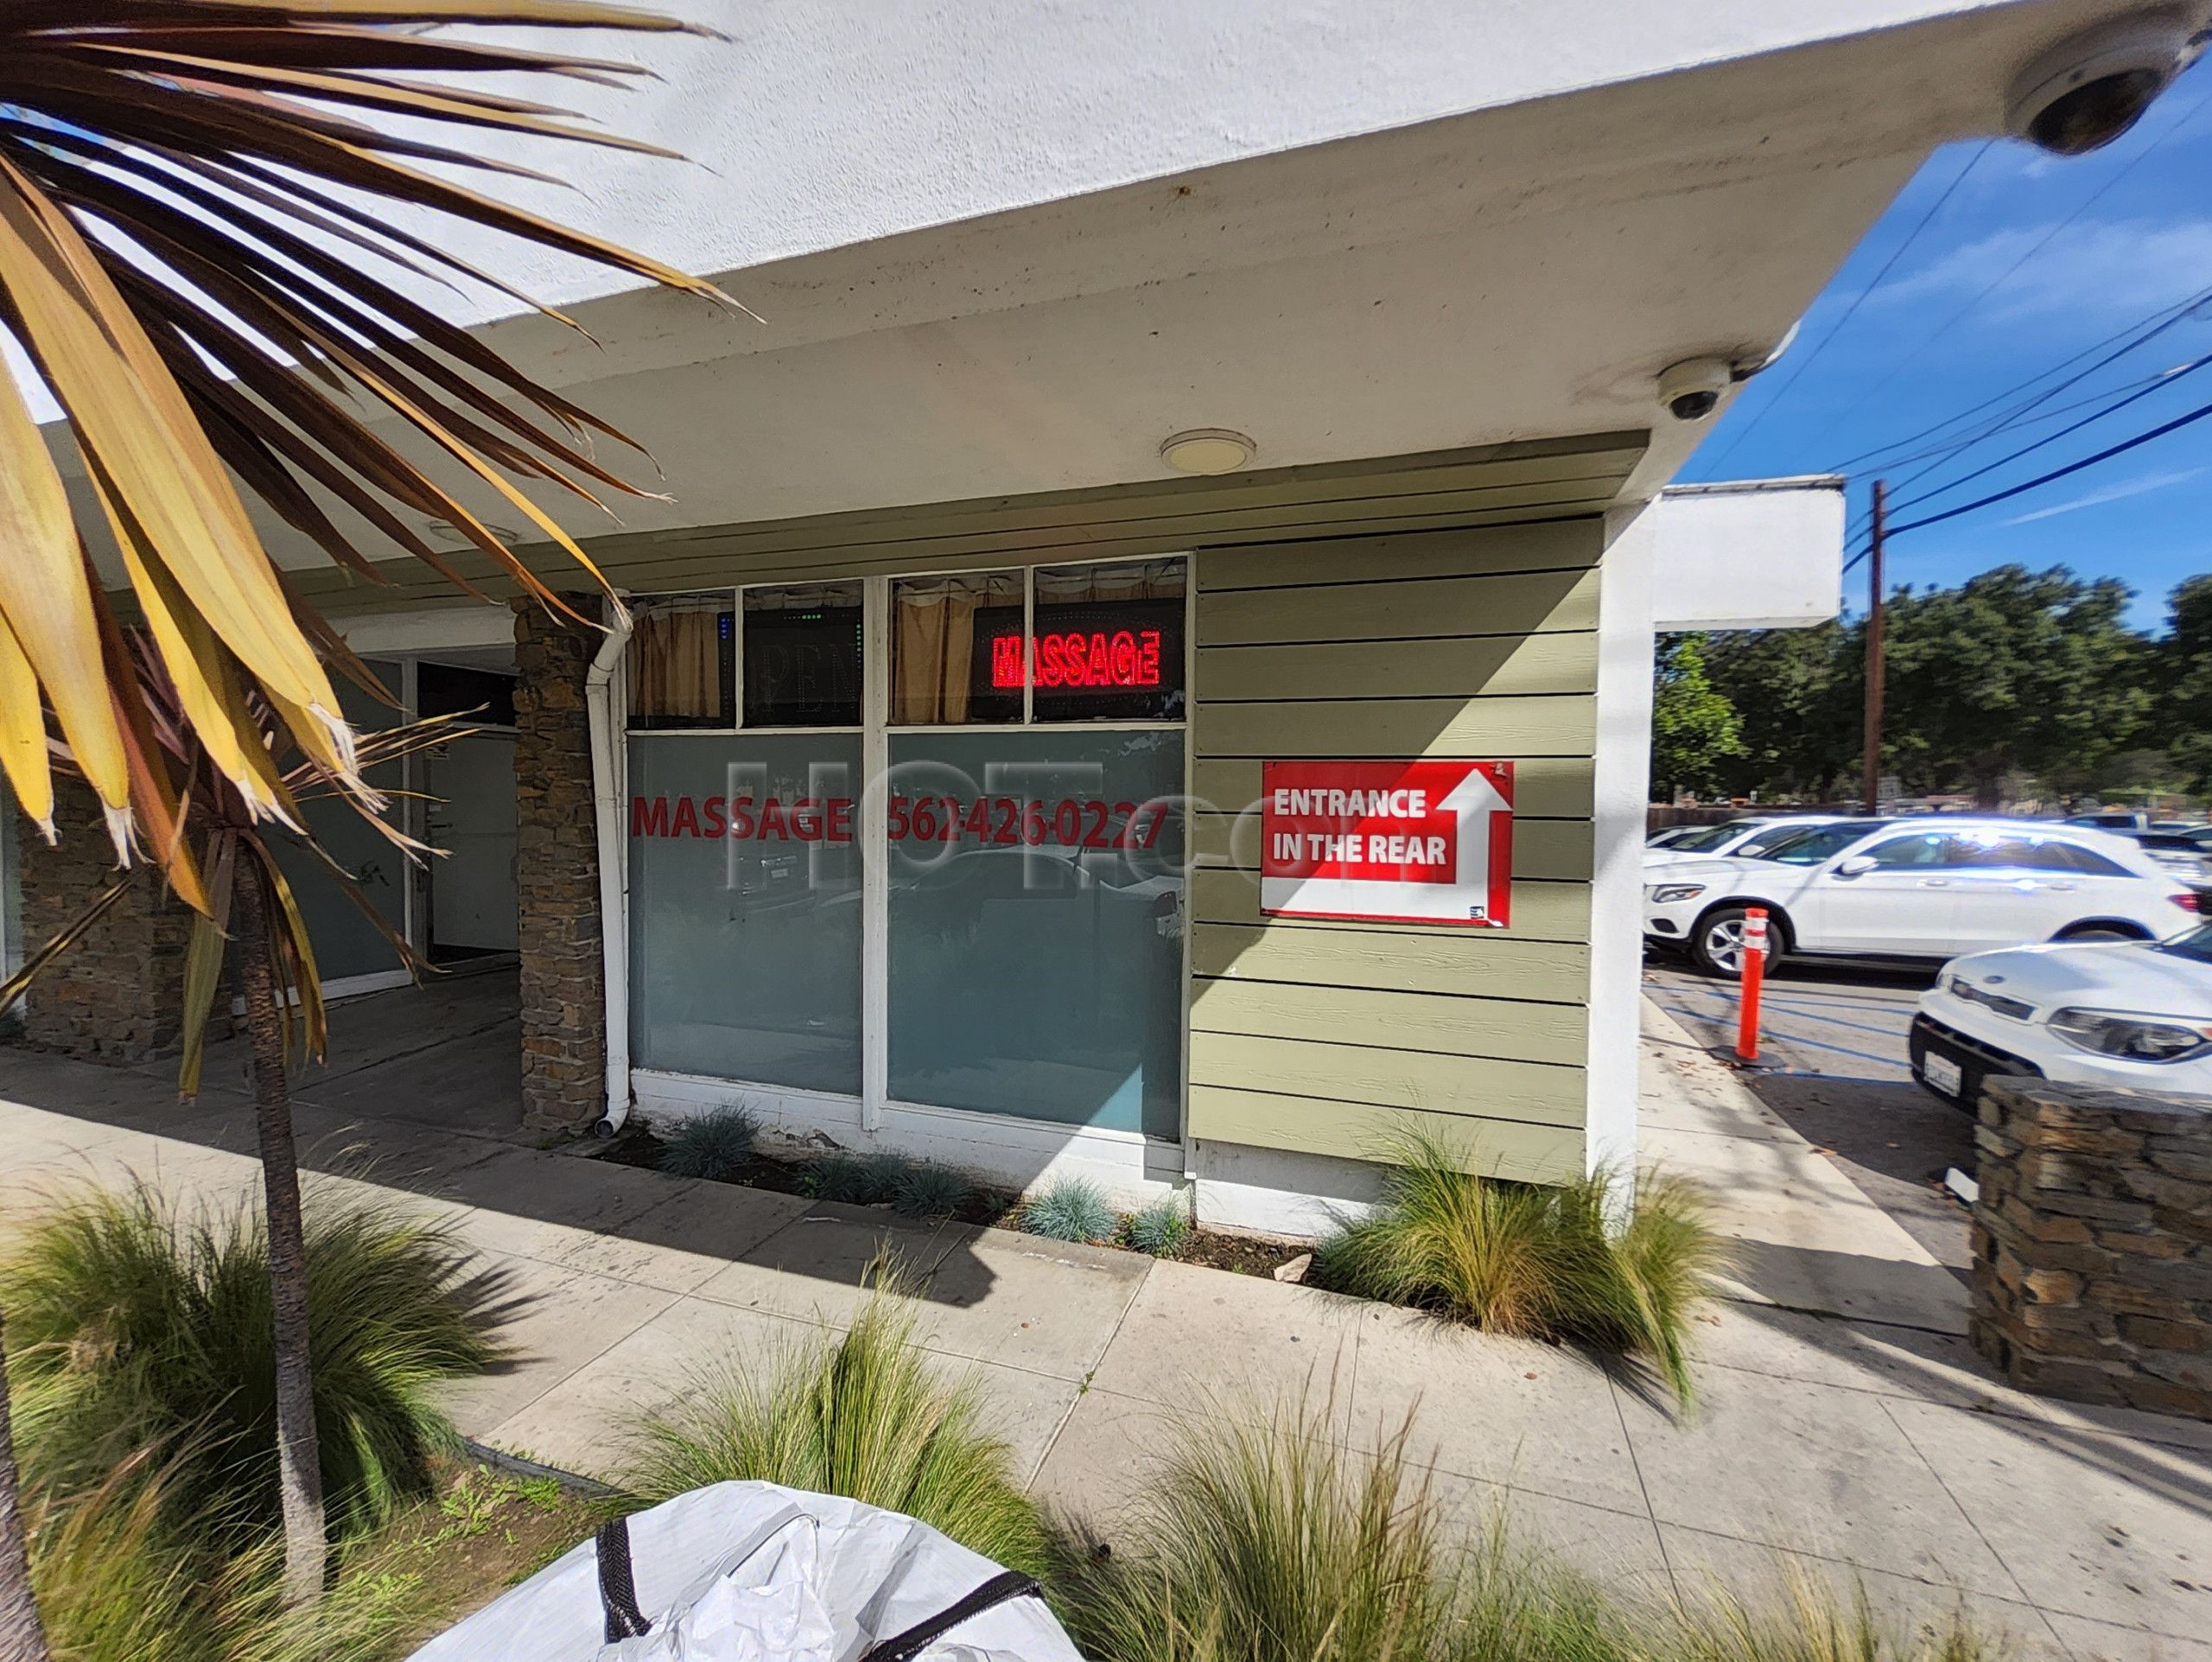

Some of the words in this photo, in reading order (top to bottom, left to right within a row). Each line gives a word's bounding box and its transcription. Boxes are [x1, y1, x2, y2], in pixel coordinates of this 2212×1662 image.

[992, 630, 1160, 687] MASSAGE
[632, 796, 852, 842] MASSAGE
[887, 796, 1168, 850] 562-426-0227
[1274, 788, 1427, 818] ENTRANCE
[1273, 832, 1302, 861] IN
[1306, 833, 1363, 863] THE
[1368, 835, 1447, 865] REAR
